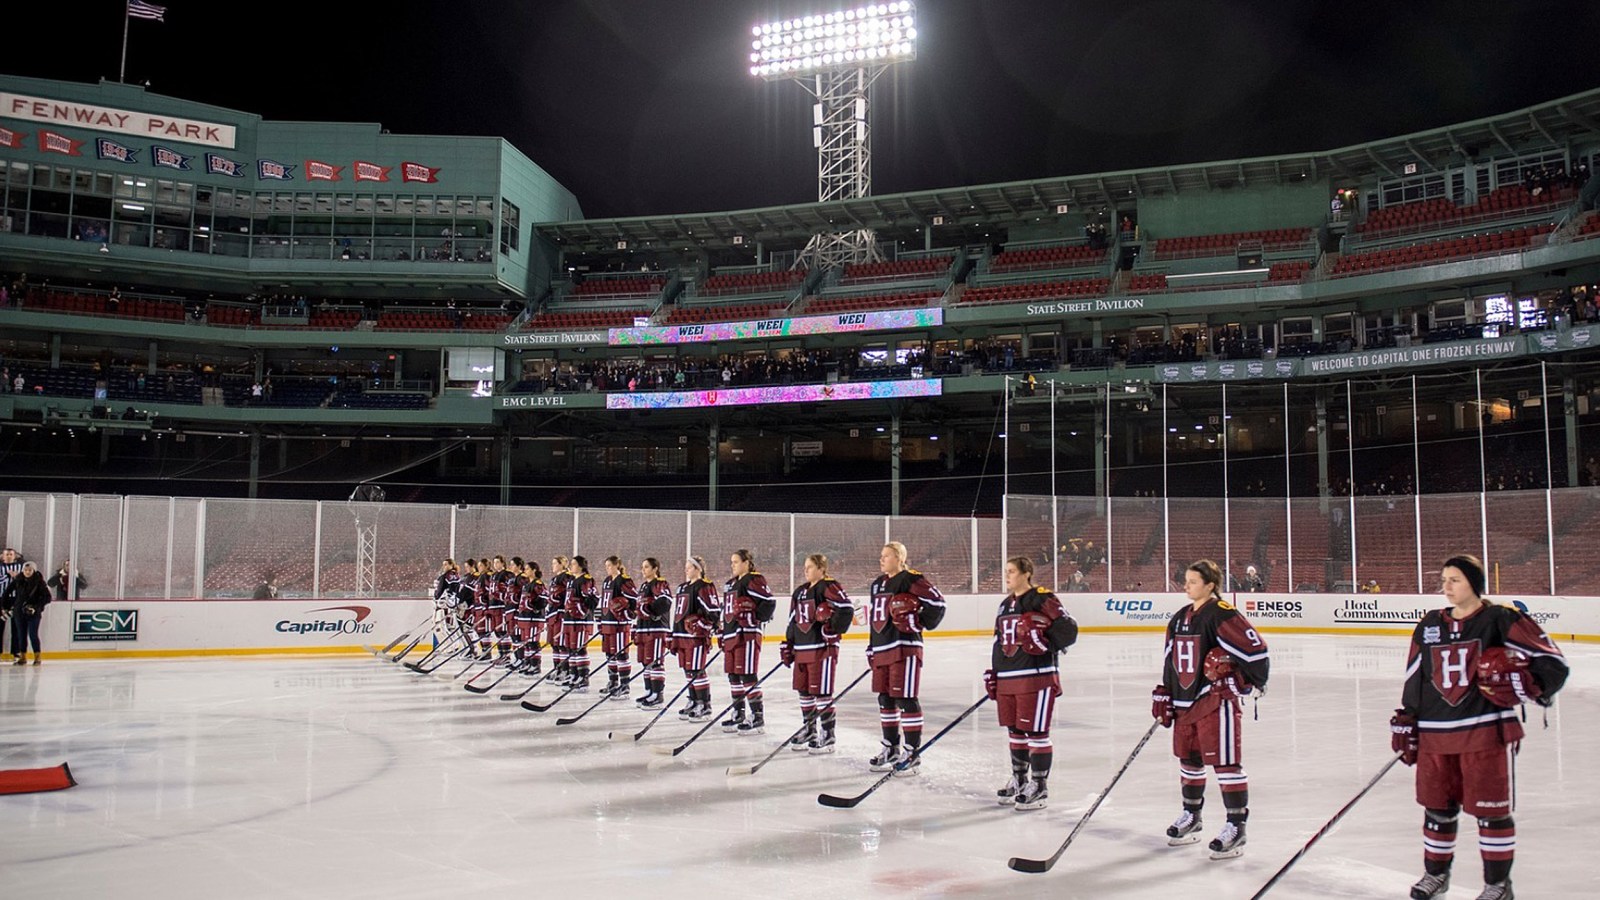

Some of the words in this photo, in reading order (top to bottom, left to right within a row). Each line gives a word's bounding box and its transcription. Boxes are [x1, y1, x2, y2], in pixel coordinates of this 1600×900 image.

[12, 99, 129, 128] FENWAY
[148, 118, 220, 142] PARK
[1027, 304, 1056, 315] STATE
[1057, 302, 1093, 312] STREET
[1095, 299, 1144, 311] PAVILION
[756, 320, 784, 331] WEEI
[838, 313, 867, 325] WEEI
[504, 334, 529, 344] STATE
[529, 334, 559, 344] STREET
[561, 333, 601, 343] PAVILION
[679, 325, 705, 336] WEEI
[1311, 356, 1354, 371] WELCOME
[1357, 355, 1369, 366] TO
[1371, 351, 1409, 365] CAPITAL
[1412, 348, 1431, 361] ONE
[1434, 345, 1472, 359] FROZEN
[1475, 341, 1515, 355] FENWAY
[503, 397, 527, 407] EMC
[530, 396, 567, 406] LEVEL
[603, 592, 611, 608] H
[675, 596, 685, 615] H
[725, 594, 734, 614] H
[1105, 598, 1153, 615] tyco
[1257, 601, 1303, 612] ENEOS
[1345, 599, 1378, 611] Hotel
[873, 597, 886, 622] H
[1126, 612, 1165, 621] Integrated
[1290, 611, 1303, 619] OIL
[75, 611, 137, 632] FSM
[1003, 618, 1018, 645] H
[1245, 628, 1261, 647] 9
[1176, 640, 1195, 673] H
[1441, 648, 1469, 689] H
